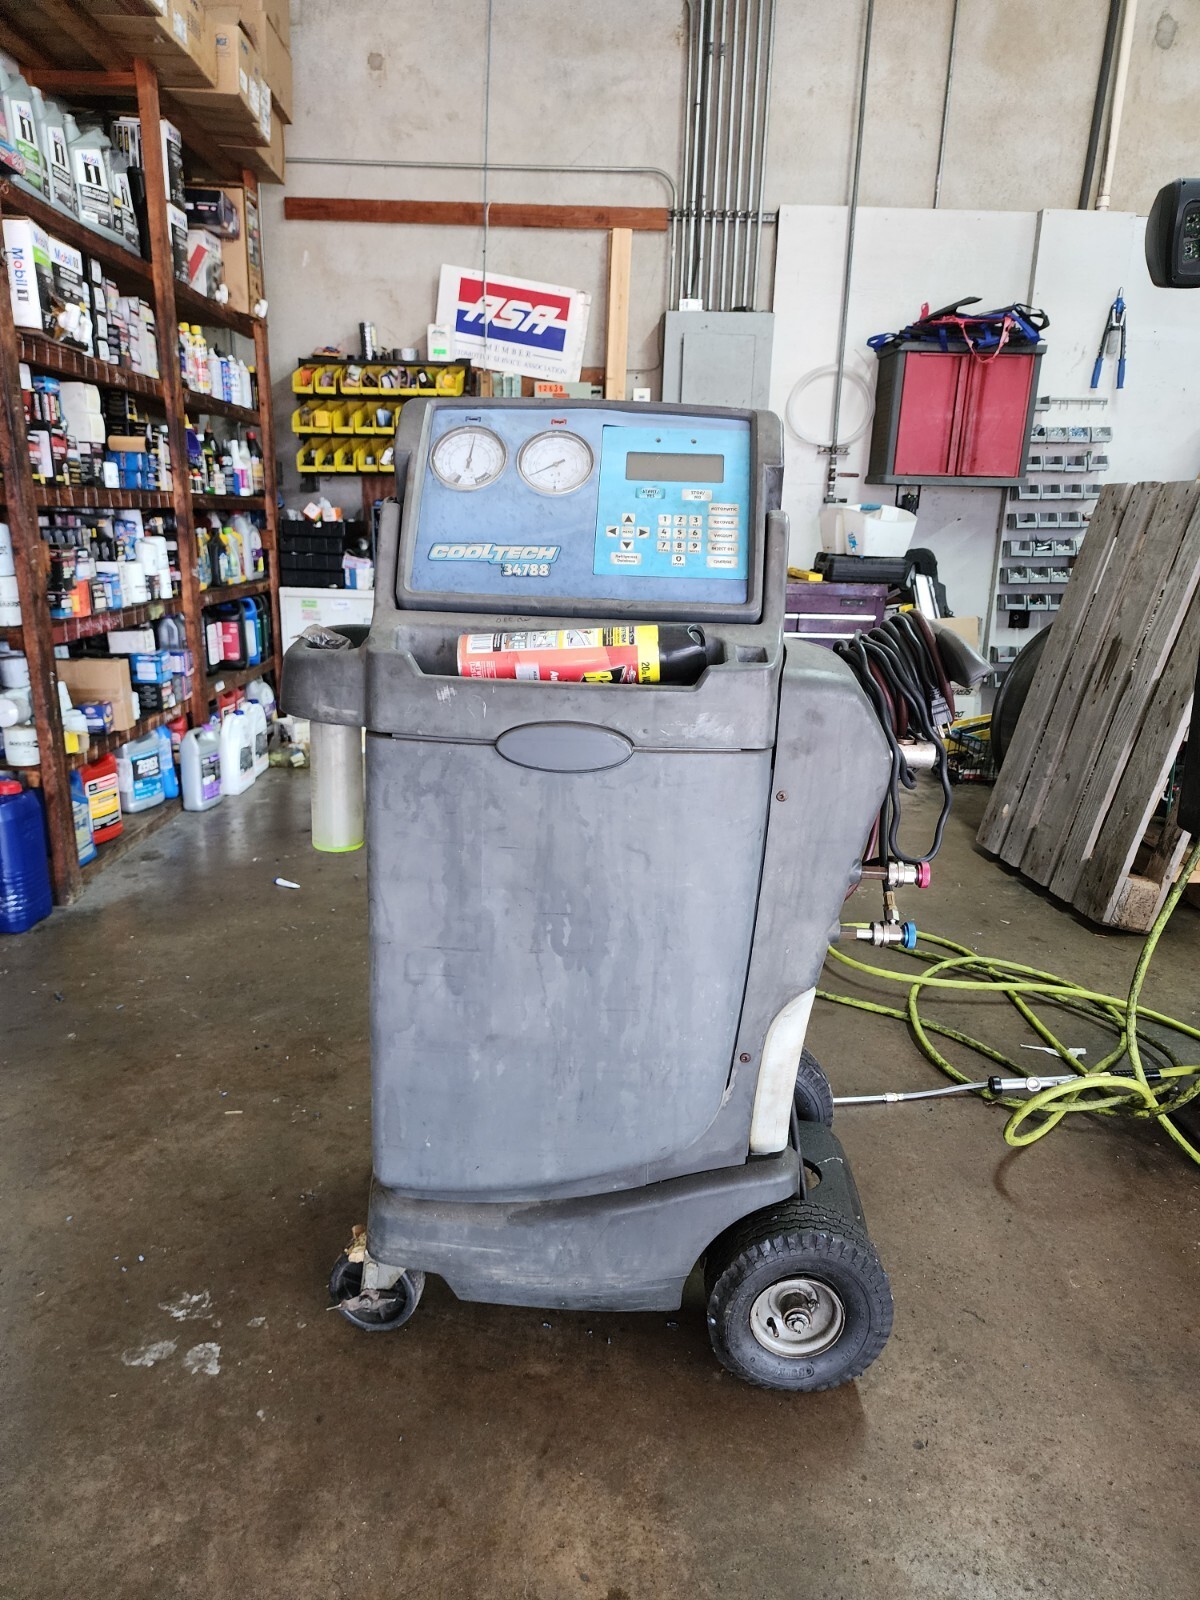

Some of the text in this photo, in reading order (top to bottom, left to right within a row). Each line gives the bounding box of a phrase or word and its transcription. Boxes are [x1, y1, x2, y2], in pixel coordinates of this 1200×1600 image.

[12, 247, 27, 287] Mobil
[431, 544, 558, 560] COOLTECH
[503, 563, 550, 577] 34788
